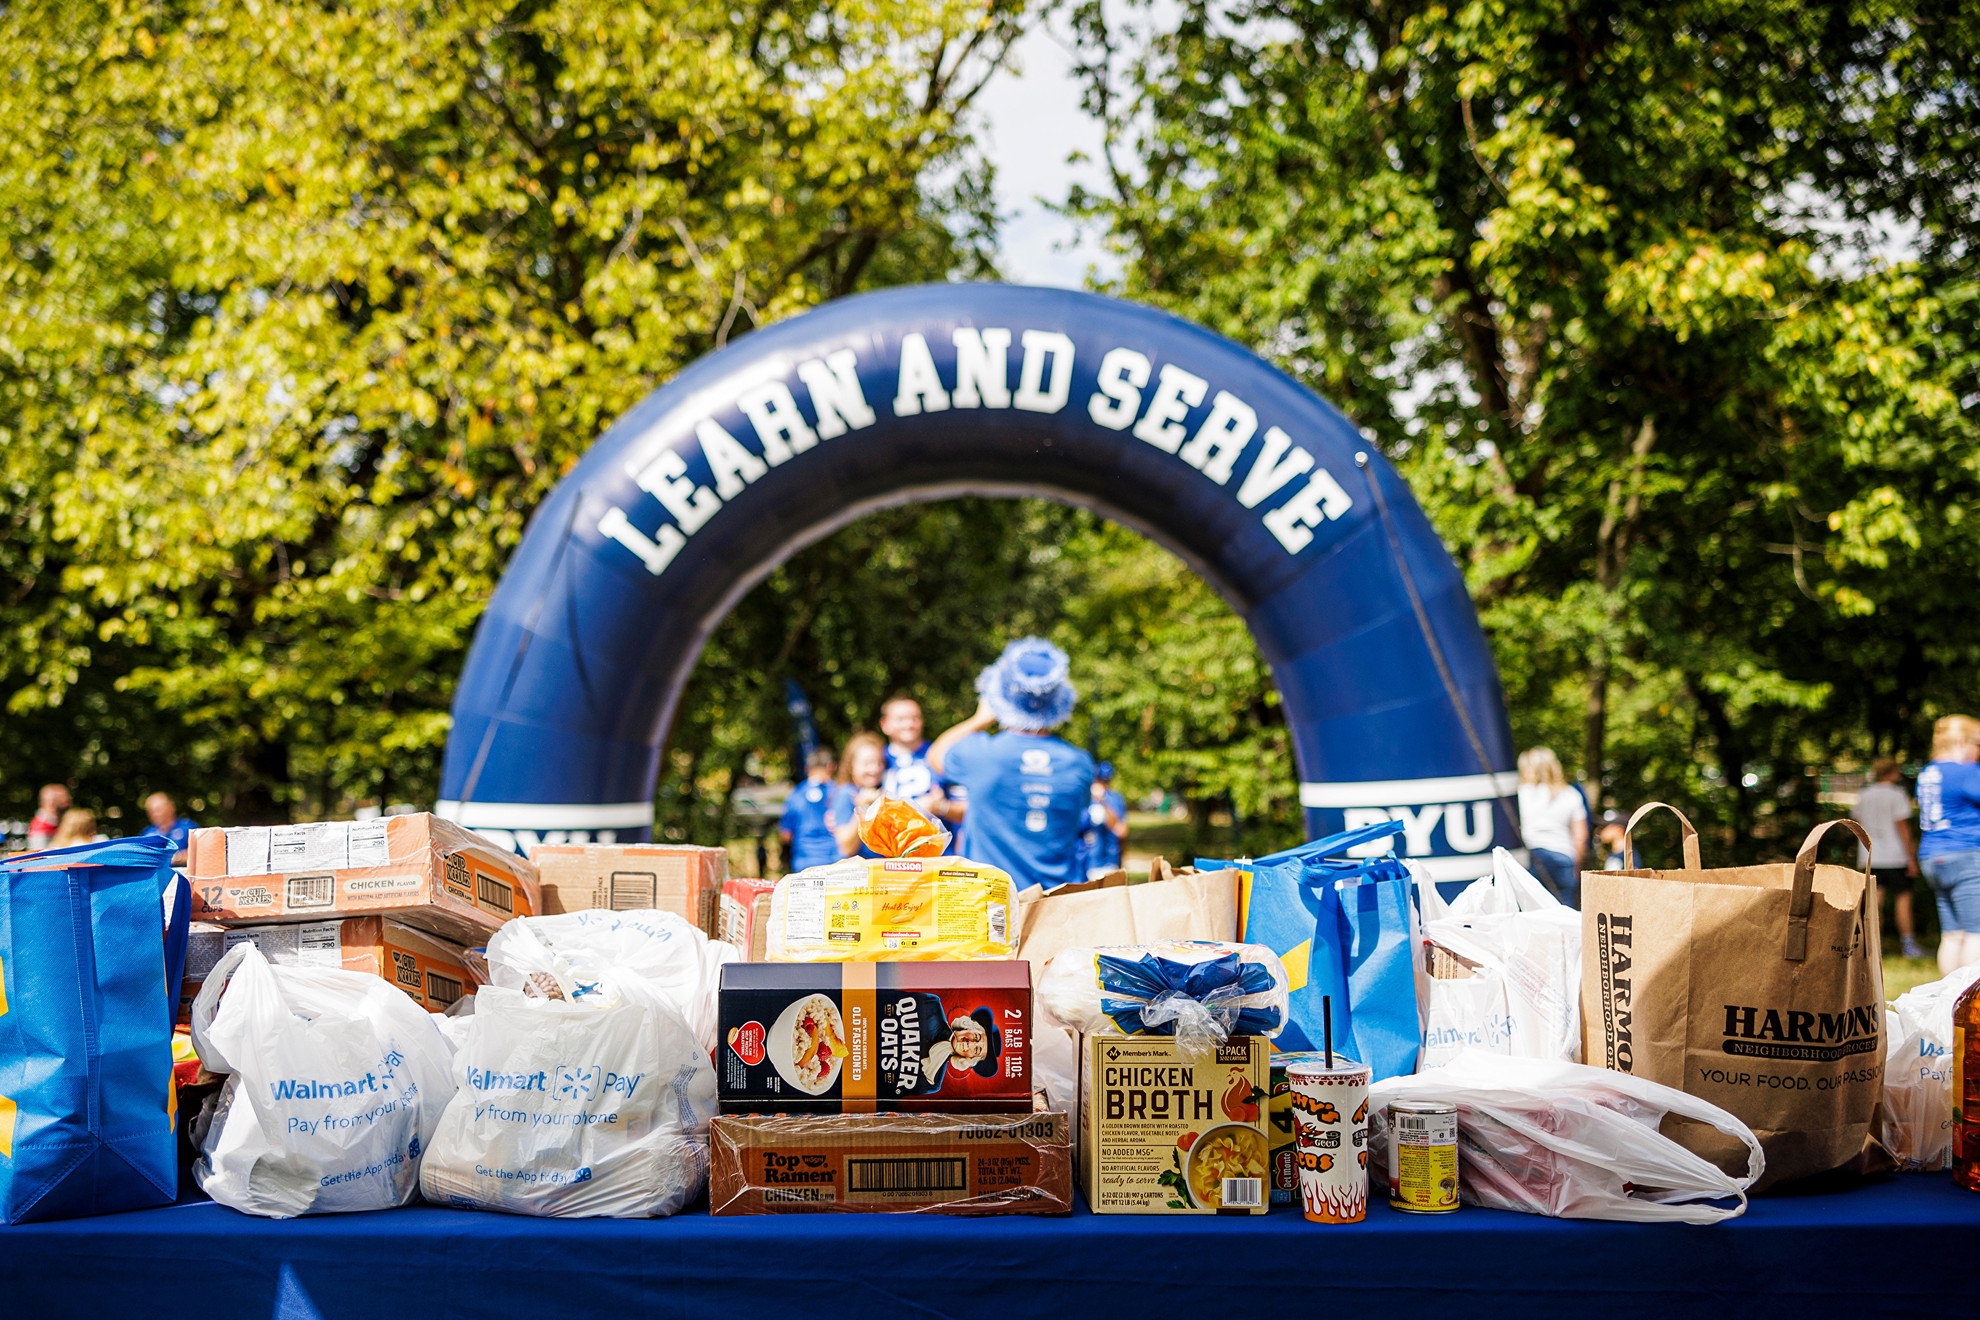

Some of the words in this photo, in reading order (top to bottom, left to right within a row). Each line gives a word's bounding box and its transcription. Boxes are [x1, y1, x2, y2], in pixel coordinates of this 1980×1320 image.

[598, 350, 877, 576] LEARN
[893, 328, 1076, 416] AND
[1087, 346, 1353, 555] SERVE
[1343, 801, 1494, 858] BYU
[246, 887, 267, 896] CUP
[350, 880, 395, 890] CHICKEN
[448, 886, 464, 898] CHICKEN
[201, 886, 223, 905] 12
[201, 905, 223, 913] CUPS
[882, 903, 897, 911] Heat
[1599, 923, 1613, 1043] NEIGHBORHOOD
[1610, 913, 1633, 1075] HARMO
[852, 1006, 861, 1026] OLD
[1004, 1009, 1022, 1019] 2
[1723, 1003, 1879, 1043] HARMONS
[881, 1018, 899, 1071] OATS
[895, 997, 920, 1090] QUAKER
[1004, 1028, 1013, 1048] BAGS
[1013, 1037, 1023, 1048] LB
[852, 1027, 861, 1081] FASHIONED
[1219, 1046, 1225, 1056] 6
[1225, 1046, 1247, 1056] PACK
[1734, 1043, 1842, 1059] NEIGHBORHOOD
[1105, 1067, 1193, 1087] CHICKEN
[1700, 1068, 1751, 1086] YOUR
[1757, 1074, 1812, 1091] FOOD.
[1816, 1075, 1842, 1091] OUR
[1920, 1067, 1946, 1083] Pay
[270, 1072, 378, 1100] Walmart
[603, 1073, 640, 1098] Pay
[1106, 1089, 1213, 1120] BROTH
[288, 1117, 320, 1136] Pay
[324, 1114, 363, 1130] from
[366, 1100, 398, 1125] your
[487, 1105, 527, 1123] from
[533, 1111, 569, 1128] your
[571, 1111, 618, 1128] phone
[1270, 1108, 1294, 1133] 4
[1315, 1139, 1338, 1148] GOOD
[763, 1152, 800, 1171] Top
[978, 1167, 996, 1175] TOTAL
[998, 1167, 1009, 1175] NET
[1284, 1153, 1292, 1176] Monte
[1299, 1151, 1334, 1173] COS
[320, 1175, 341, 1187] Get
[344, 1170, 362, 1182] the
[364, 1164, 383, 1177] App
[475, 1165, 494, 1178] Get
[495, 1168, 513, 1180] the
[516, 1170, 537, 1184] App
[764, 1168, 834, 1183] Ramen
[978, 1177, 987, 1185] 4.5
[989, 1177, 996, 1185] LB
[1103, 1175, 1124, 1187] ready
[1126, 1176, 1134, 1184] to
[1284, 1177, 1292, 1188] Del
[765, 1188, 820, 1202] CHICKEN
